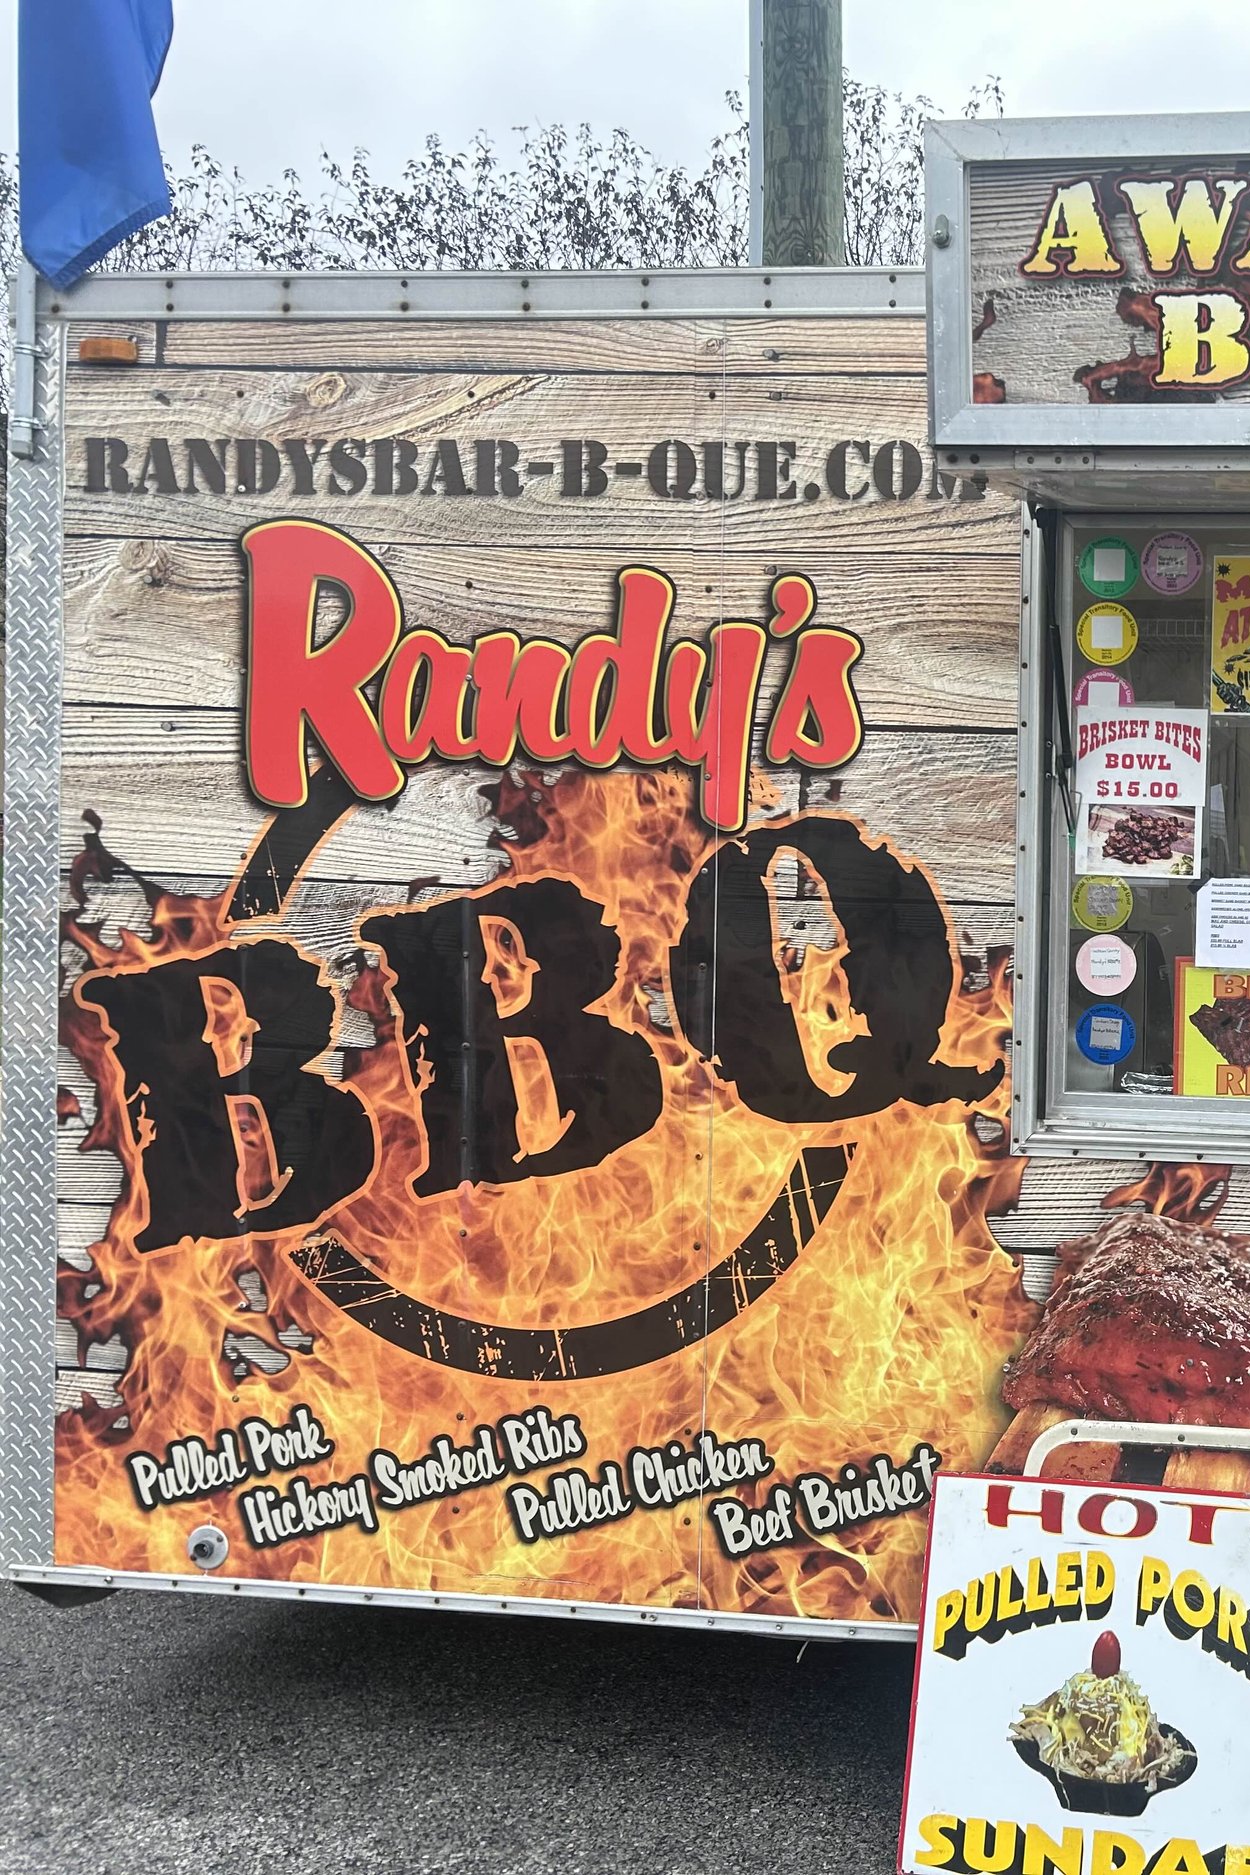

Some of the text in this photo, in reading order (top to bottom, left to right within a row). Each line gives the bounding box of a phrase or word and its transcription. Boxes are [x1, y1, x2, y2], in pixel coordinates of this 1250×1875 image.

[84, 437, 987, 501] RANDYSBAR-B-QUE.COM
[1078, 614, 1089, 637] Special
[1089, 604, 1119, 615] Transitory
[1119, 608, 1133, 622] Food
[242, 519, 863, 833] Randy's
[1086, 671, 1116, 681] Transitory
[1078, 719, 1202, 764] BRISKET BITES
[1097, 780, 1179, 799] $15.00
[1105, 753, 1171, 771] BOWL
[75, 813, 1008, 1254] BBQ
[131, 1407, 331, 1505] Pulled Pork
[243, 1411, 585, 1544] Hickory Smoked Ribs
[513, 1436, 772, 1540] Pulled Chicken
[714, 1452, 938, 1556] Beef Brisket
[933, 1550, 1116, 1661] PULLED
